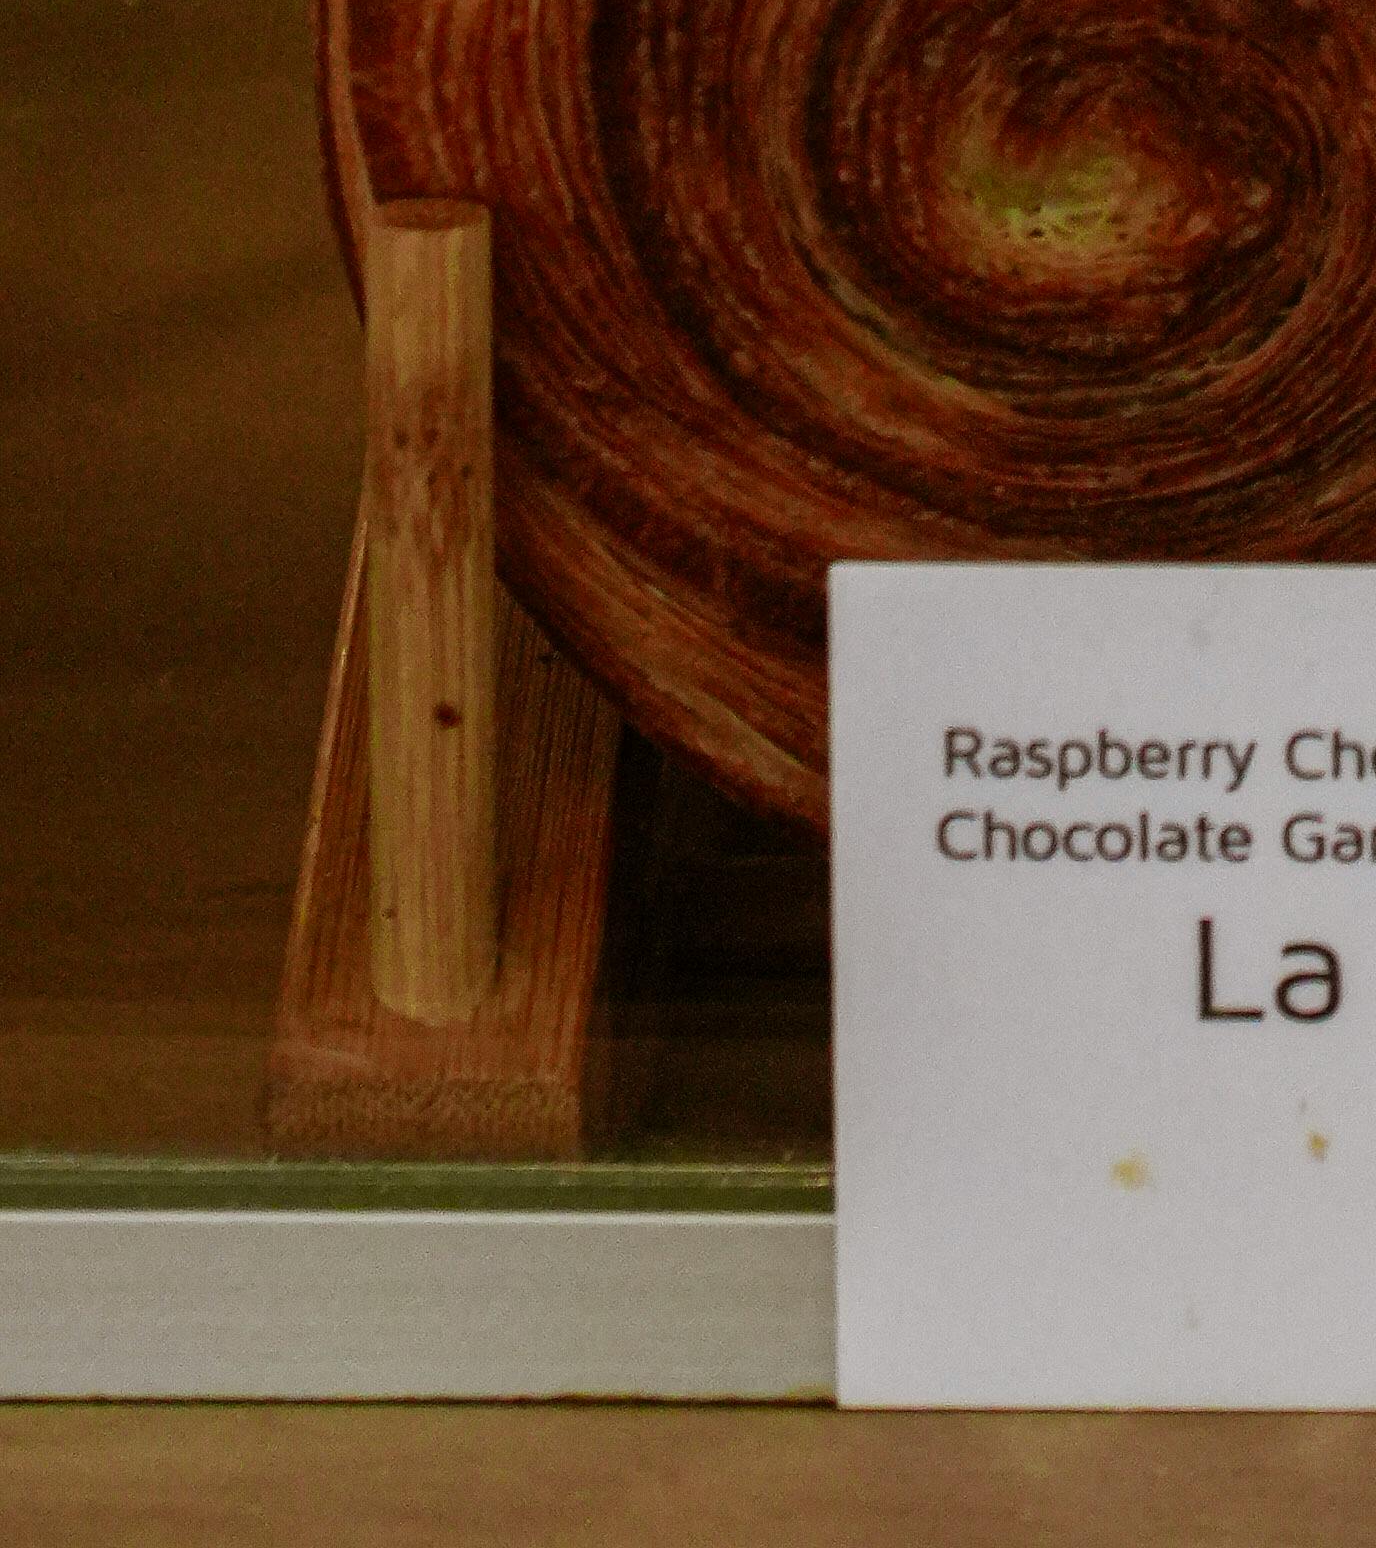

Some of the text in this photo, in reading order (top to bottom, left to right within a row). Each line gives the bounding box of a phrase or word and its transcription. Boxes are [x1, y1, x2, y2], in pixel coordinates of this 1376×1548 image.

[942, 725, 1258, 794] Raspberry
[934, 808, 1254, 865] Chocolate
[1195, 915, 1345, 1027] La
